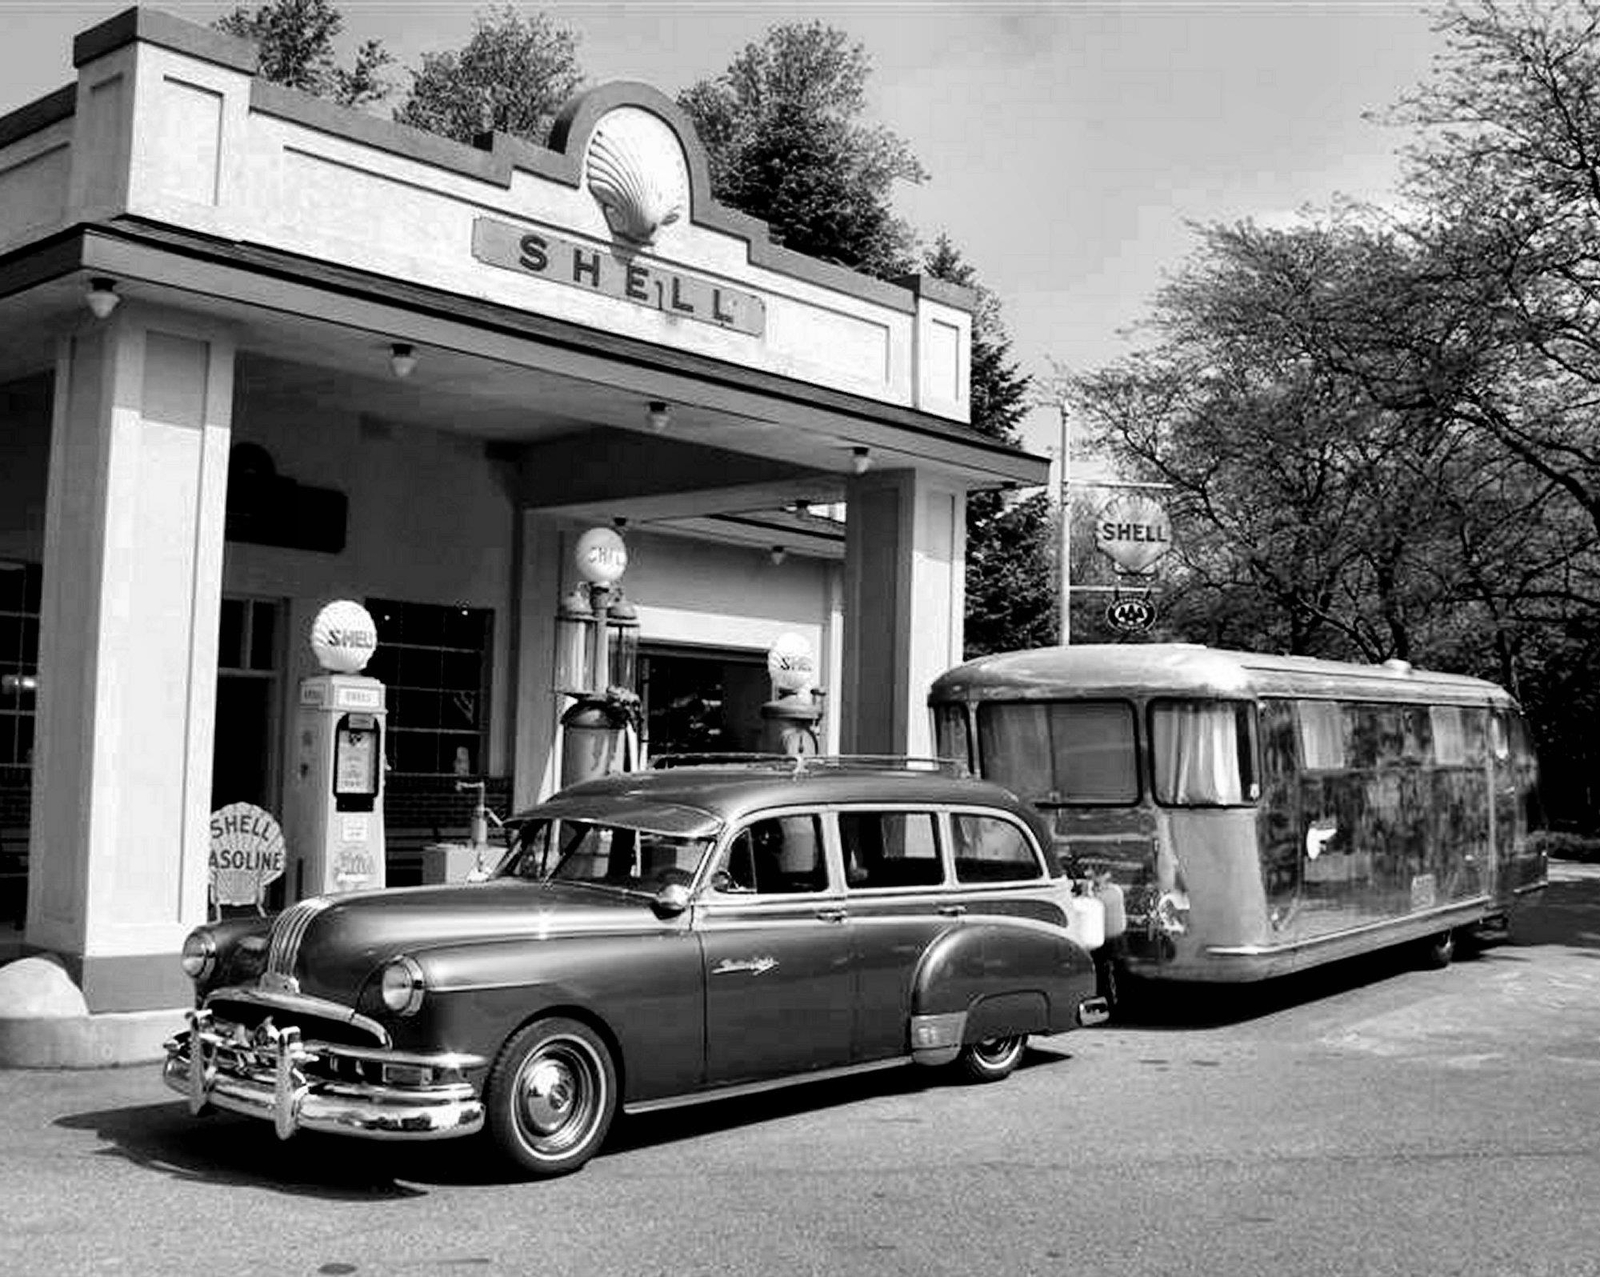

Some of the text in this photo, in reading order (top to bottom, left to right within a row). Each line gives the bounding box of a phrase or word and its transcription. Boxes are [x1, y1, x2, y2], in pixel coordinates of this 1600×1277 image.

[519, 234, 734, 322] SHELL
[1103, 523, 1168, 542] SHELL
[209, 814, 270, 841] SHELL
